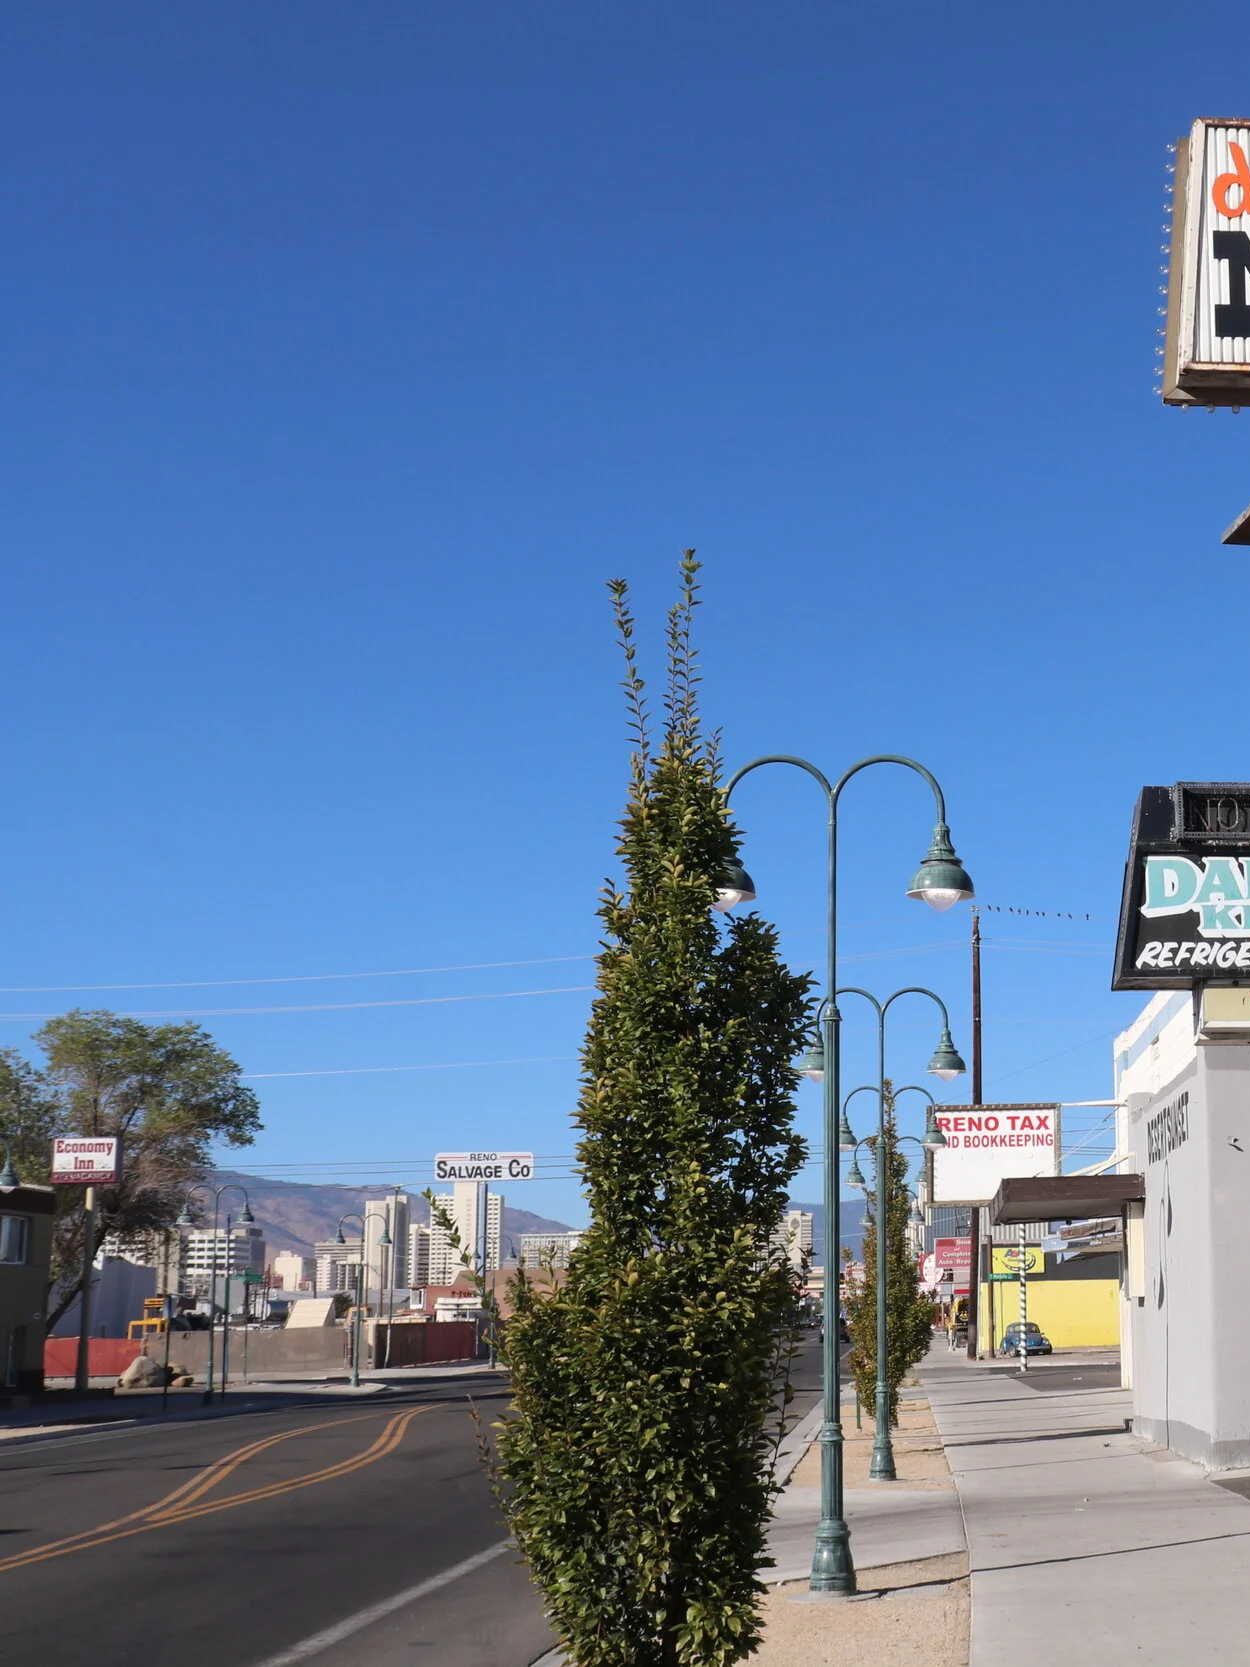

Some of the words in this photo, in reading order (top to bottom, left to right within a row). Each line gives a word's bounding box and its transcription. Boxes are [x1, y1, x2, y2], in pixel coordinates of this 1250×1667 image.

[937, 1116, 999, 1132] RENO
[1006, 1115, 1050, 1131] TAX
[57, 1140, 114, 1156] Economy
[942, 1136, 959, 1149] ND
[963, 1134, 1054, 1148] BOOKKEEPING
[73, 1157, 94, 1170] Inn
[469, 1153, 498, 1161] RENO
